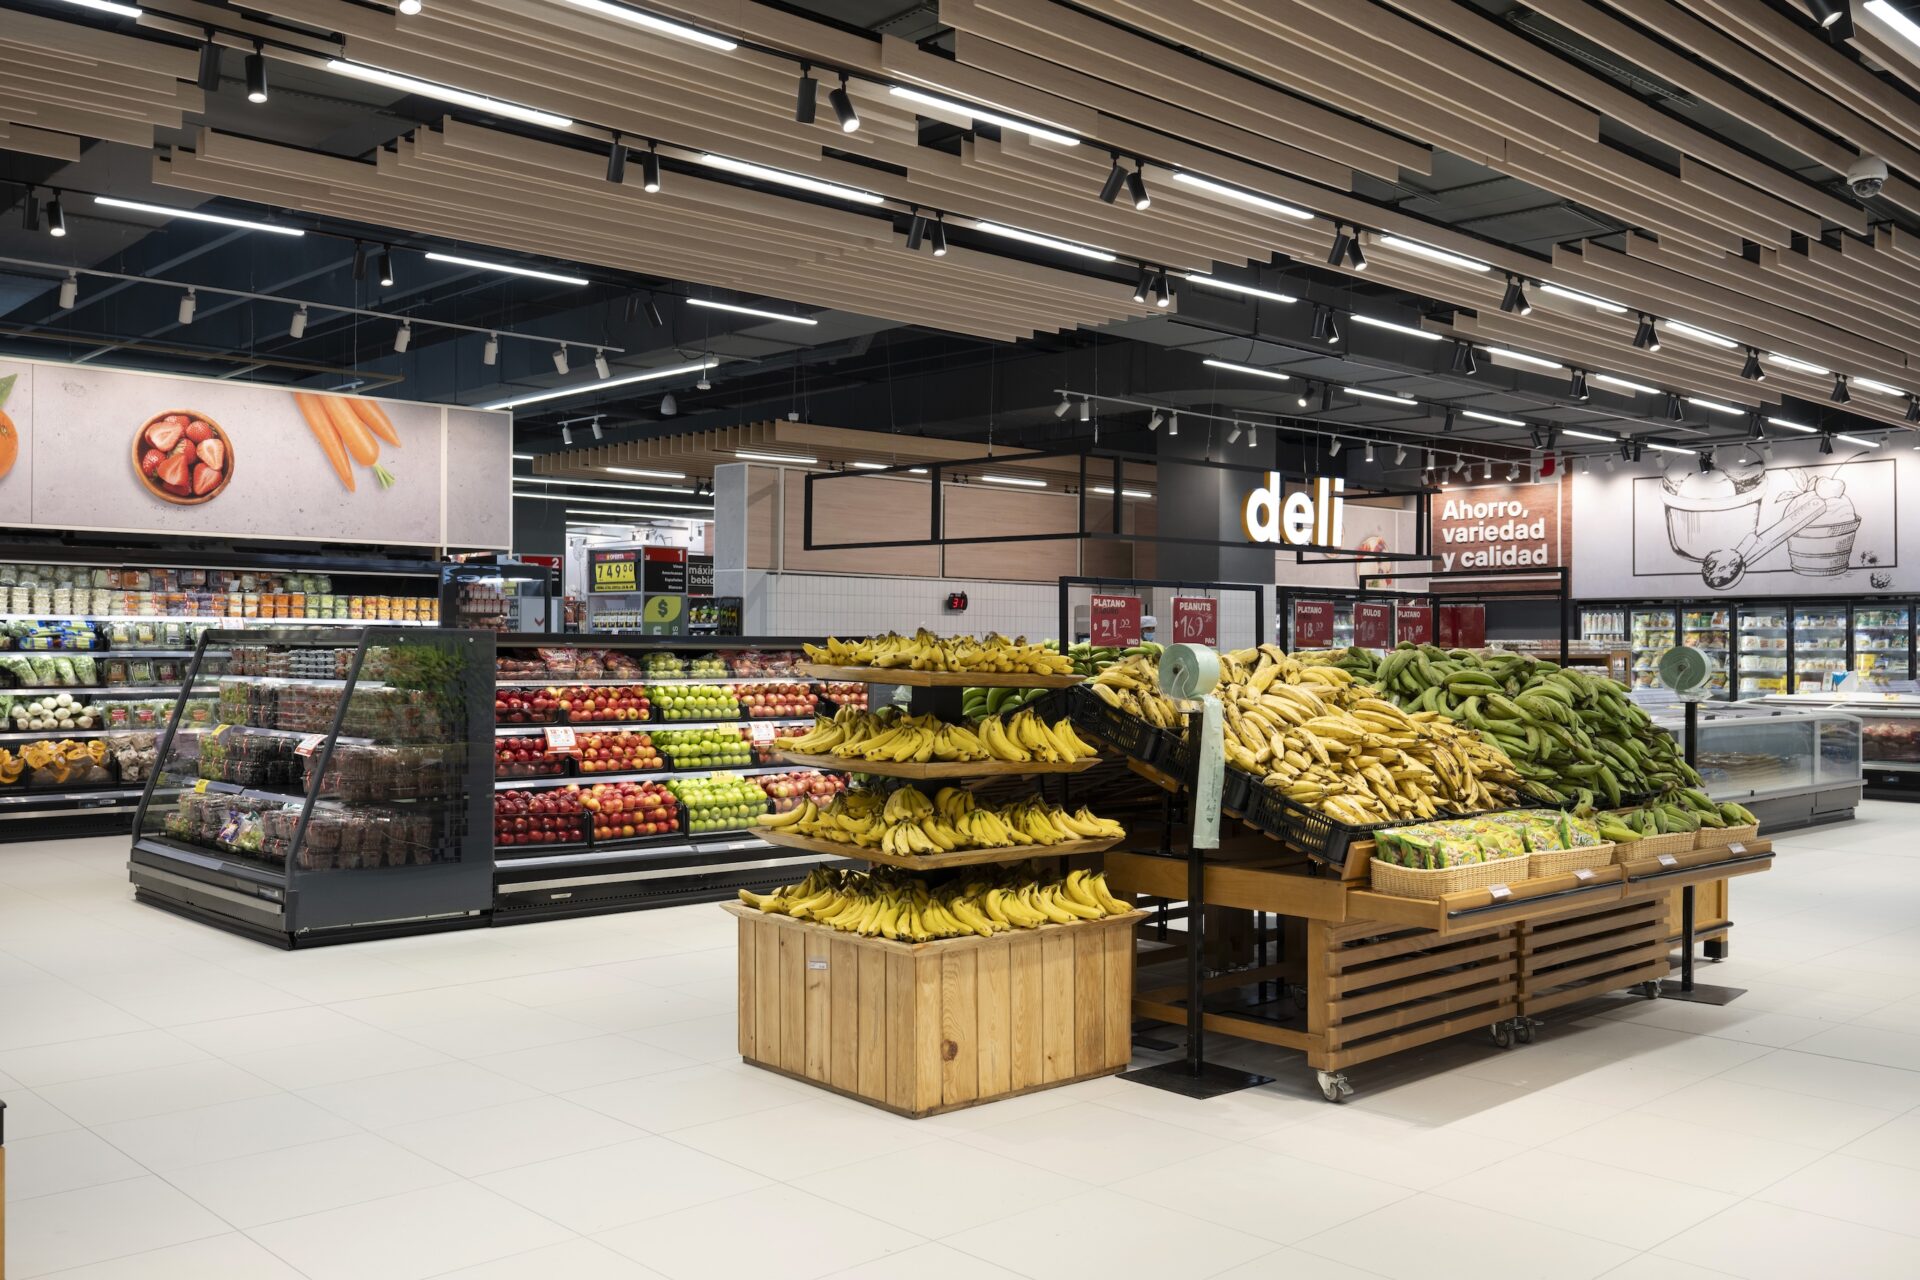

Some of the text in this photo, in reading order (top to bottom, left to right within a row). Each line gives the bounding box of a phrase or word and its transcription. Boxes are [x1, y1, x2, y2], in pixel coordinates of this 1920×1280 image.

[1242, 471, 1344, 547] deli
[1441, 500, 1529, 520] Ahorro,
[1441, 517, 1545, 543] variedad
[677, 549, 683, 562] 1
[1441, 543, 1548, 572] y calidad
[552, 557, 559, 568] 2
[1093, 598, 1126, 608] PLATANO
[1179, 601, 1211, 611] PEANUTS
[1297, 605, 1323, 615] PLATANO
[1362, 608, 1382, 618] RULOS
[1398, 610, 1420, 618] PLATANO
